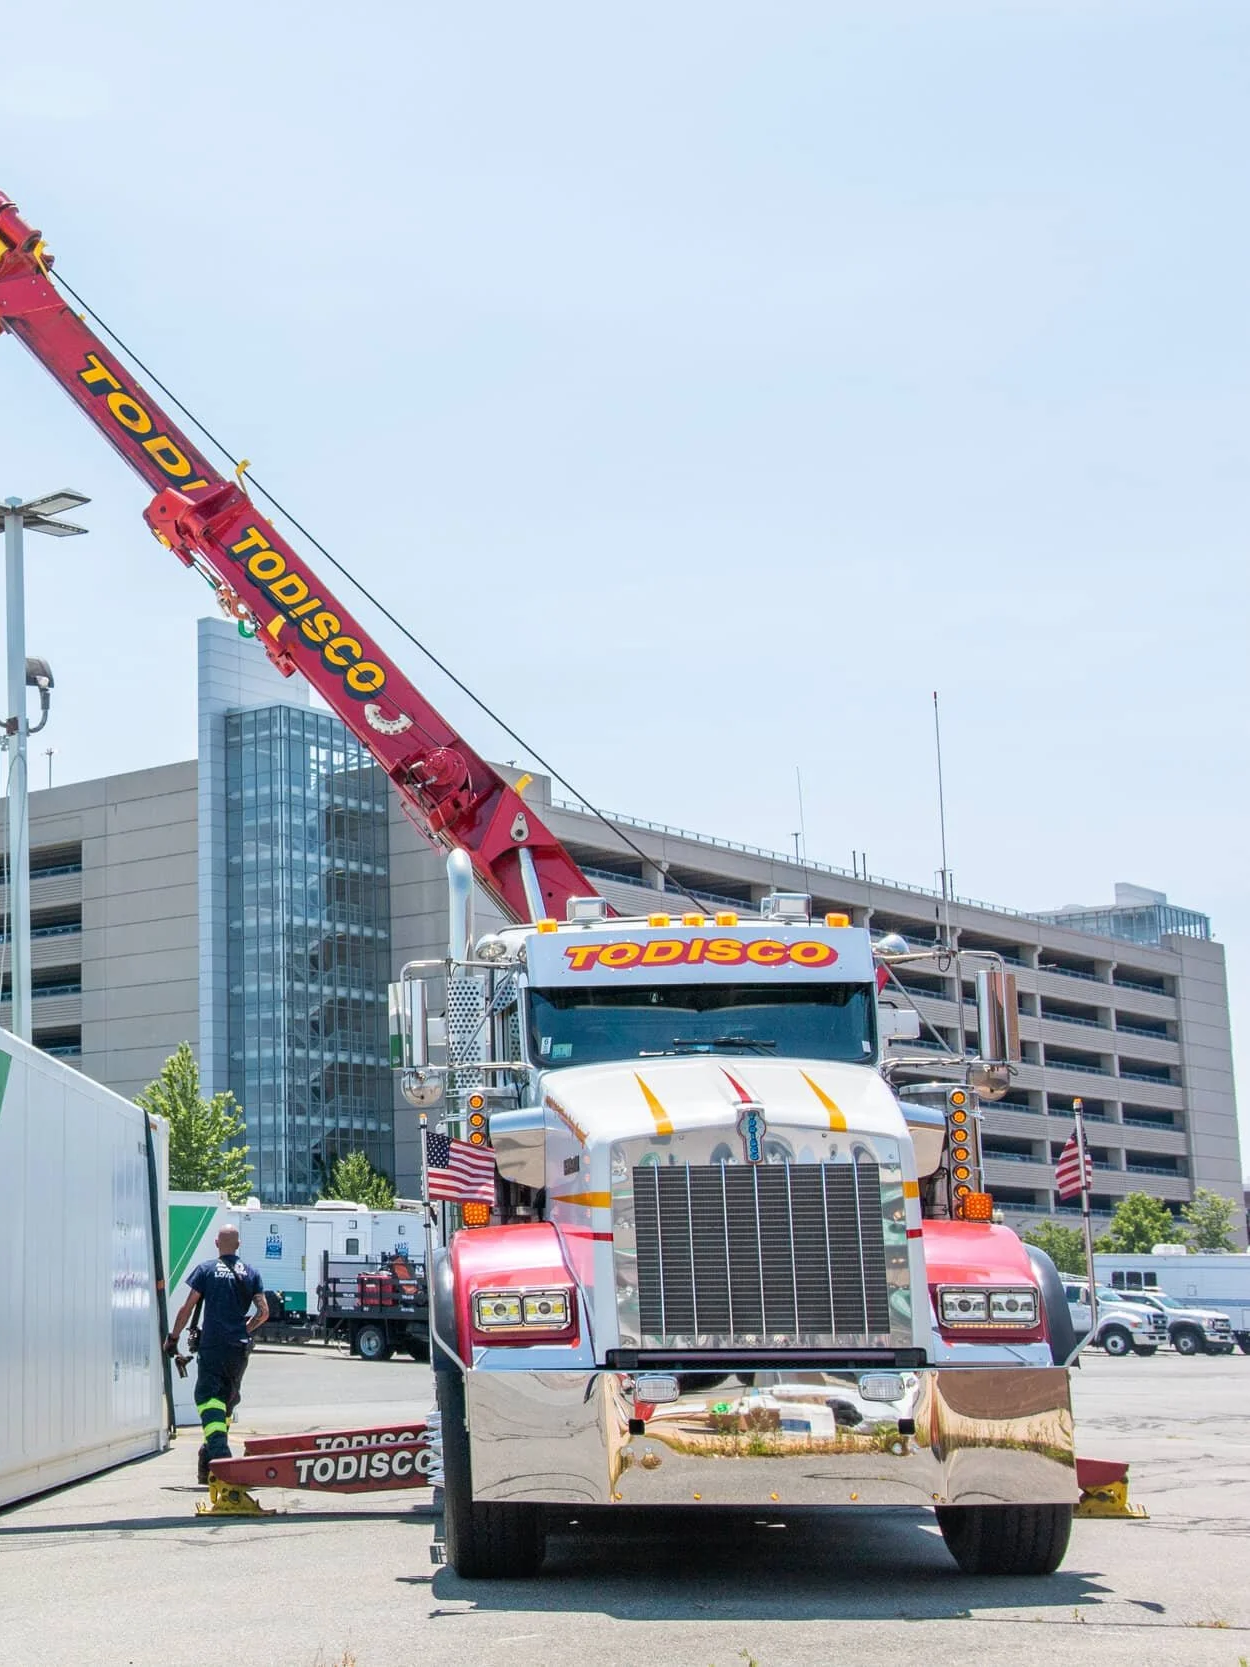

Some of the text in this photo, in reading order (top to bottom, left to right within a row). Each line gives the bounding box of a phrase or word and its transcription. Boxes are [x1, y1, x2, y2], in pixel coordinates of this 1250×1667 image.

[227, 525, 387, 700] TODISCO
[565, 938, 838, 971] TODISCO
[296, 1449, 432, 1483] TODISCO
